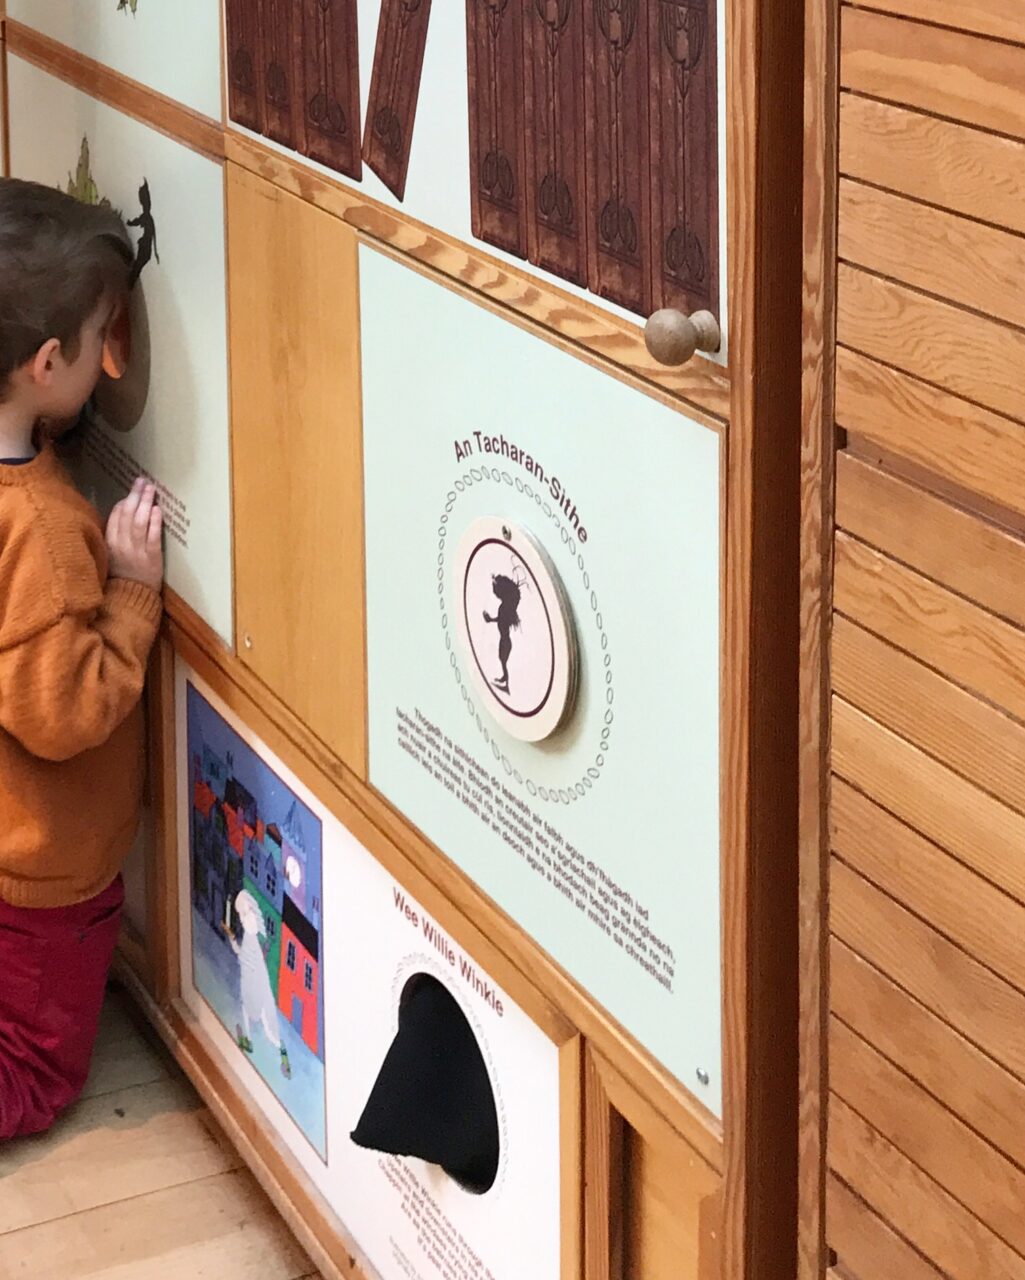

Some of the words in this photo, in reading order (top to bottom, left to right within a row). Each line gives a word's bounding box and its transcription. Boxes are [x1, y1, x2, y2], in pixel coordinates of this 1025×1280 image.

[454, 439, 473, 463] An
[526, 854, 545, 876] agus
[565, 842, 585, 865] agus
[636, 902, 648, 921] iad
[590, 892, 609, 921] beag
[649, 949, 660, 965] no
[663, 961, 674, 977] na
[598, 887, 618, 911] agus
[620, 907, 631, 924] ag
[393, 886, 419, 928] Wee
[422, 916, 456, 967] Willie
[459, 955, 504, 1018] Winkie
